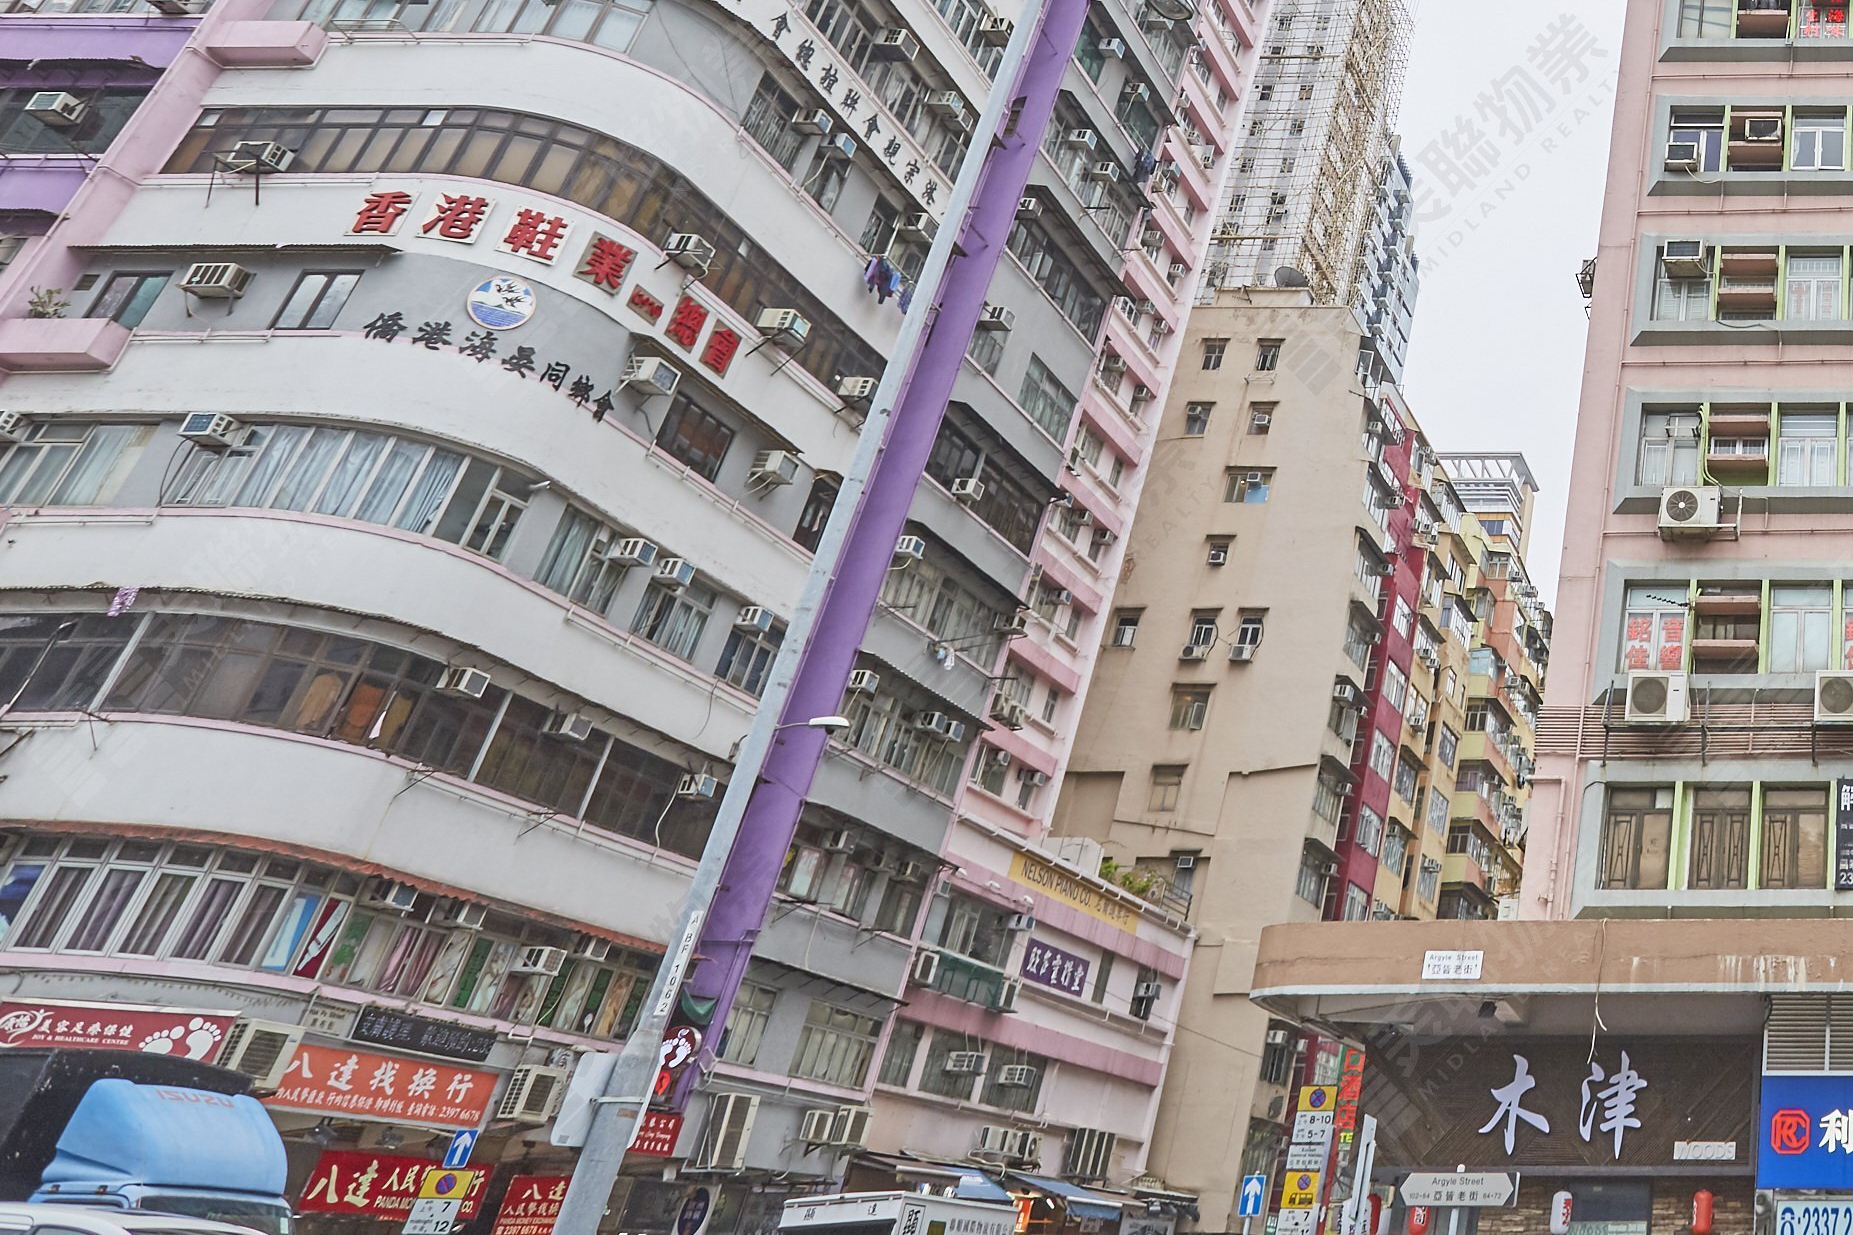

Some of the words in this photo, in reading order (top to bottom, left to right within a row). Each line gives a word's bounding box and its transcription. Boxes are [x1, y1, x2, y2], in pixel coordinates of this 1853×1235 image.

[1021, 860, 1053, 890] NELSON
[1053, 876, 1079, 901] PIANO
[1429, 954, 1452, 962] Argyle
[156, 1090, 235, 1109] ISUZU
[1478, 1050, 1648, 1160] 木津
[439, 1105, 459, 1119] 2397
[1309, 1115, 1331, 1125] 8-10
[1677, 1144, 1735, 1160] WOODS
[1432, 1177, 1457, 1186] Argyle
[1459, 1177, 1484, 1186] Street
[1433, 1190, 1479, 1202] 亞皆老街
